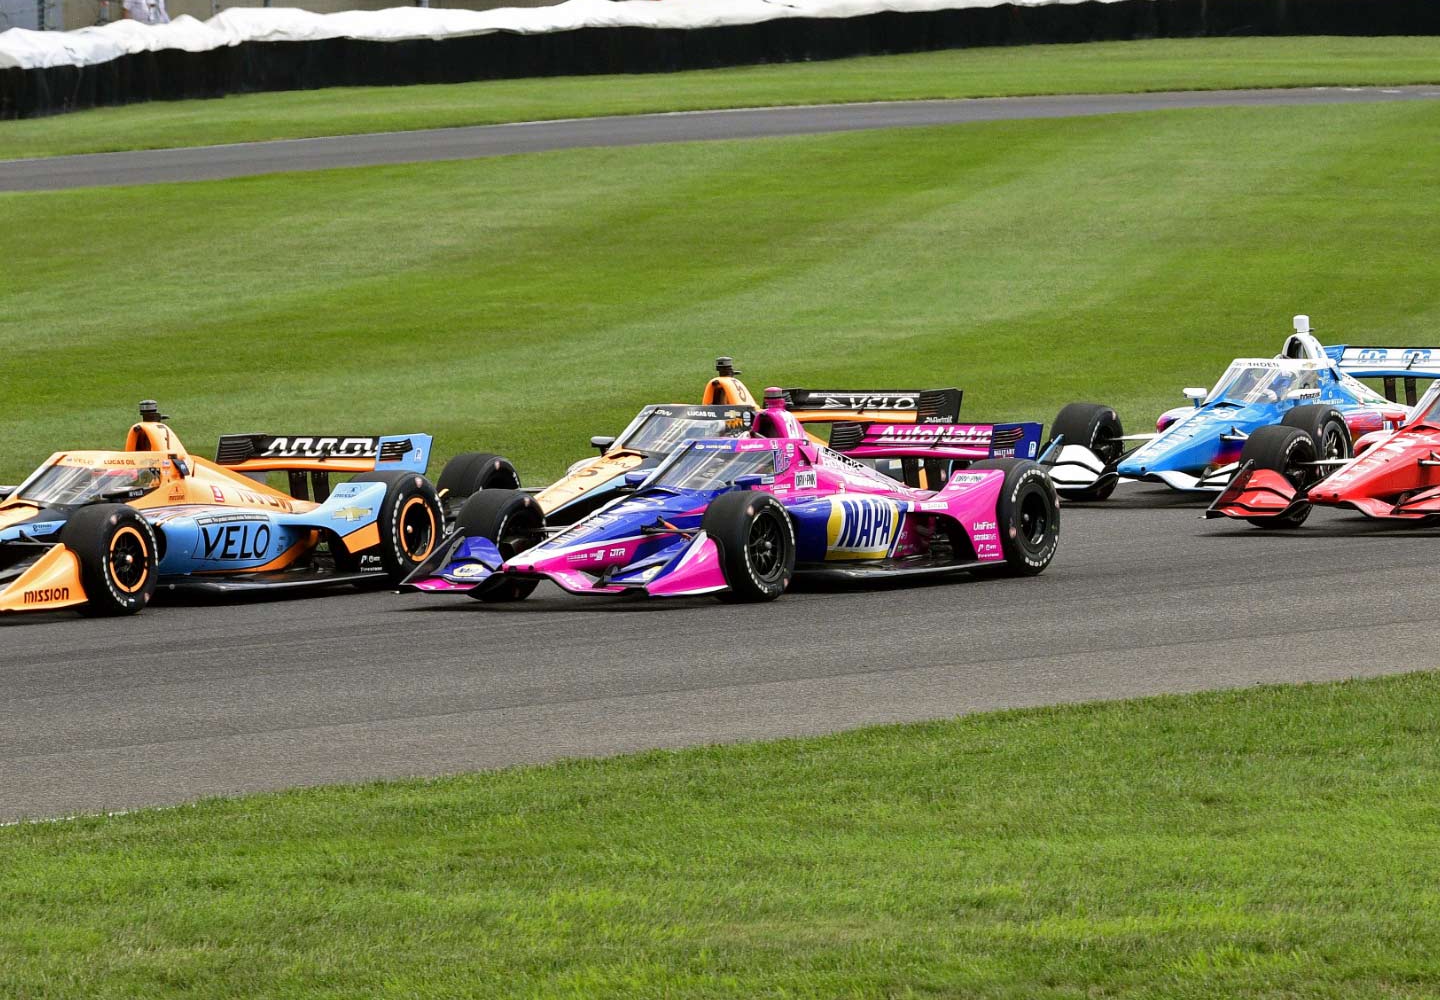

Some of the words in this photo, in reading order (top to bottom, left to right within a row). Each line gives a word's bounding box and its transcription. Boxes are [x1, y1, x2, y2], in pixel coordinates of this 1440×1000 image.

[849, 396, 916, 410] VELO
[837, 500, 893, 548] NAPA
[973, 522, 996, 531] UniFirst
[201, 523, 271, 560] VELO
[24, 587, 70, 604] mission
